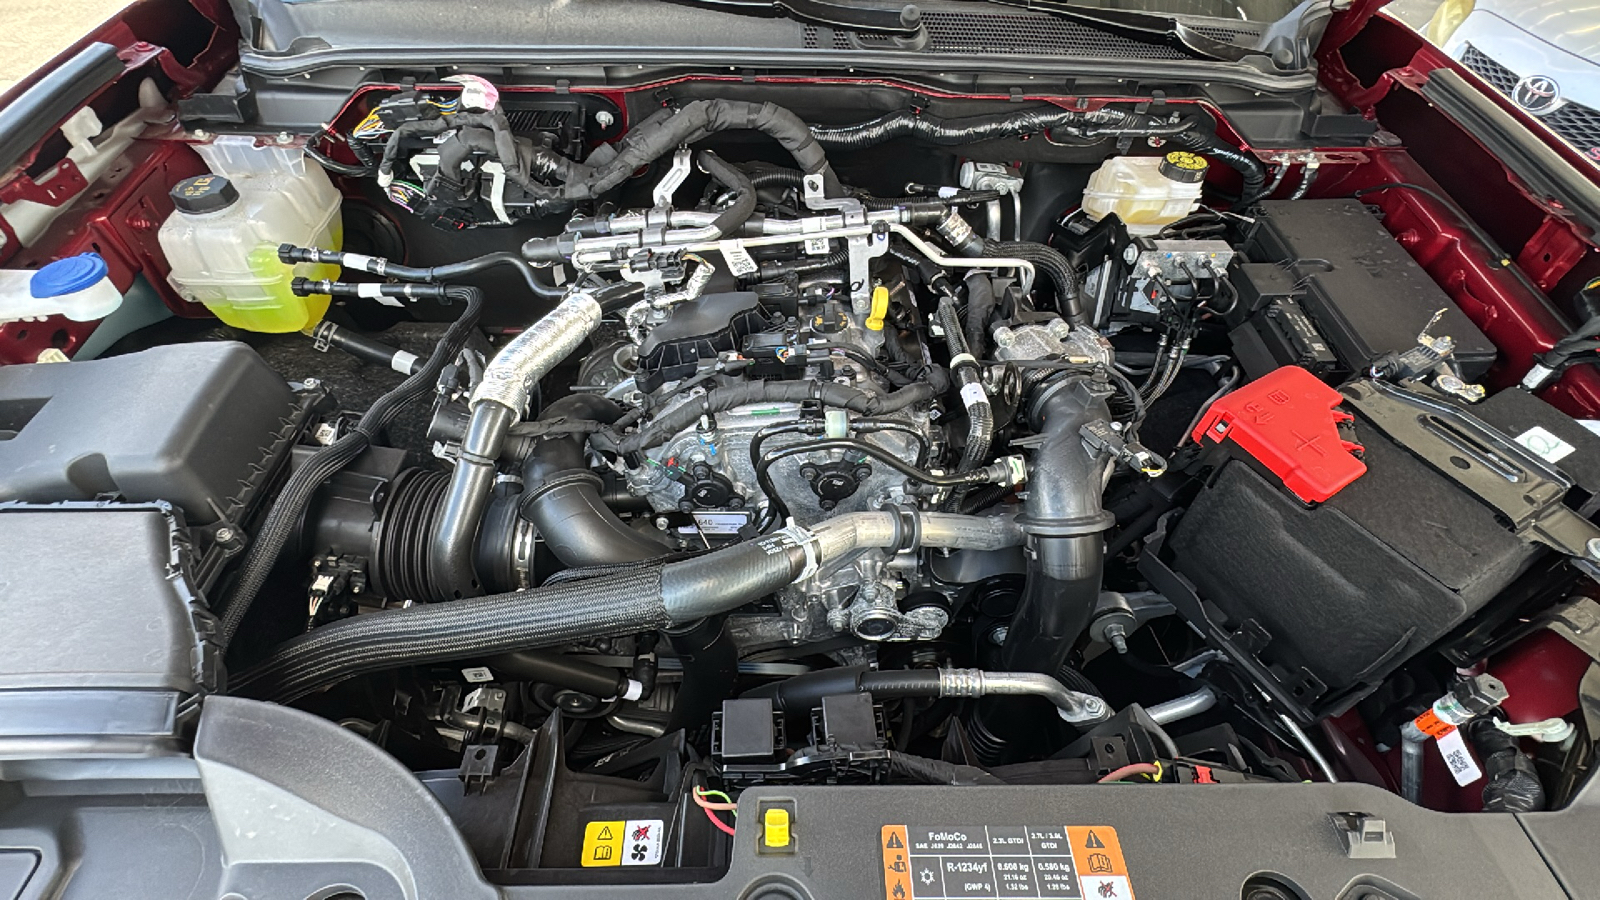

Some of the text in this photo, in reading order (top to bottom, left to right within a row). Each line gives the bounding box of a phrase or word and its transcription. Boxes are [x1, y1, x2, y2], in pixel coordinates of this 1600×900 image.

[928, 832, 967, 841] FoMoCo
[946, 862, 988, 874] R-1234yf
[1018, 862, 1029, 872] kg
[1059, 862, 1071, 872] kg
